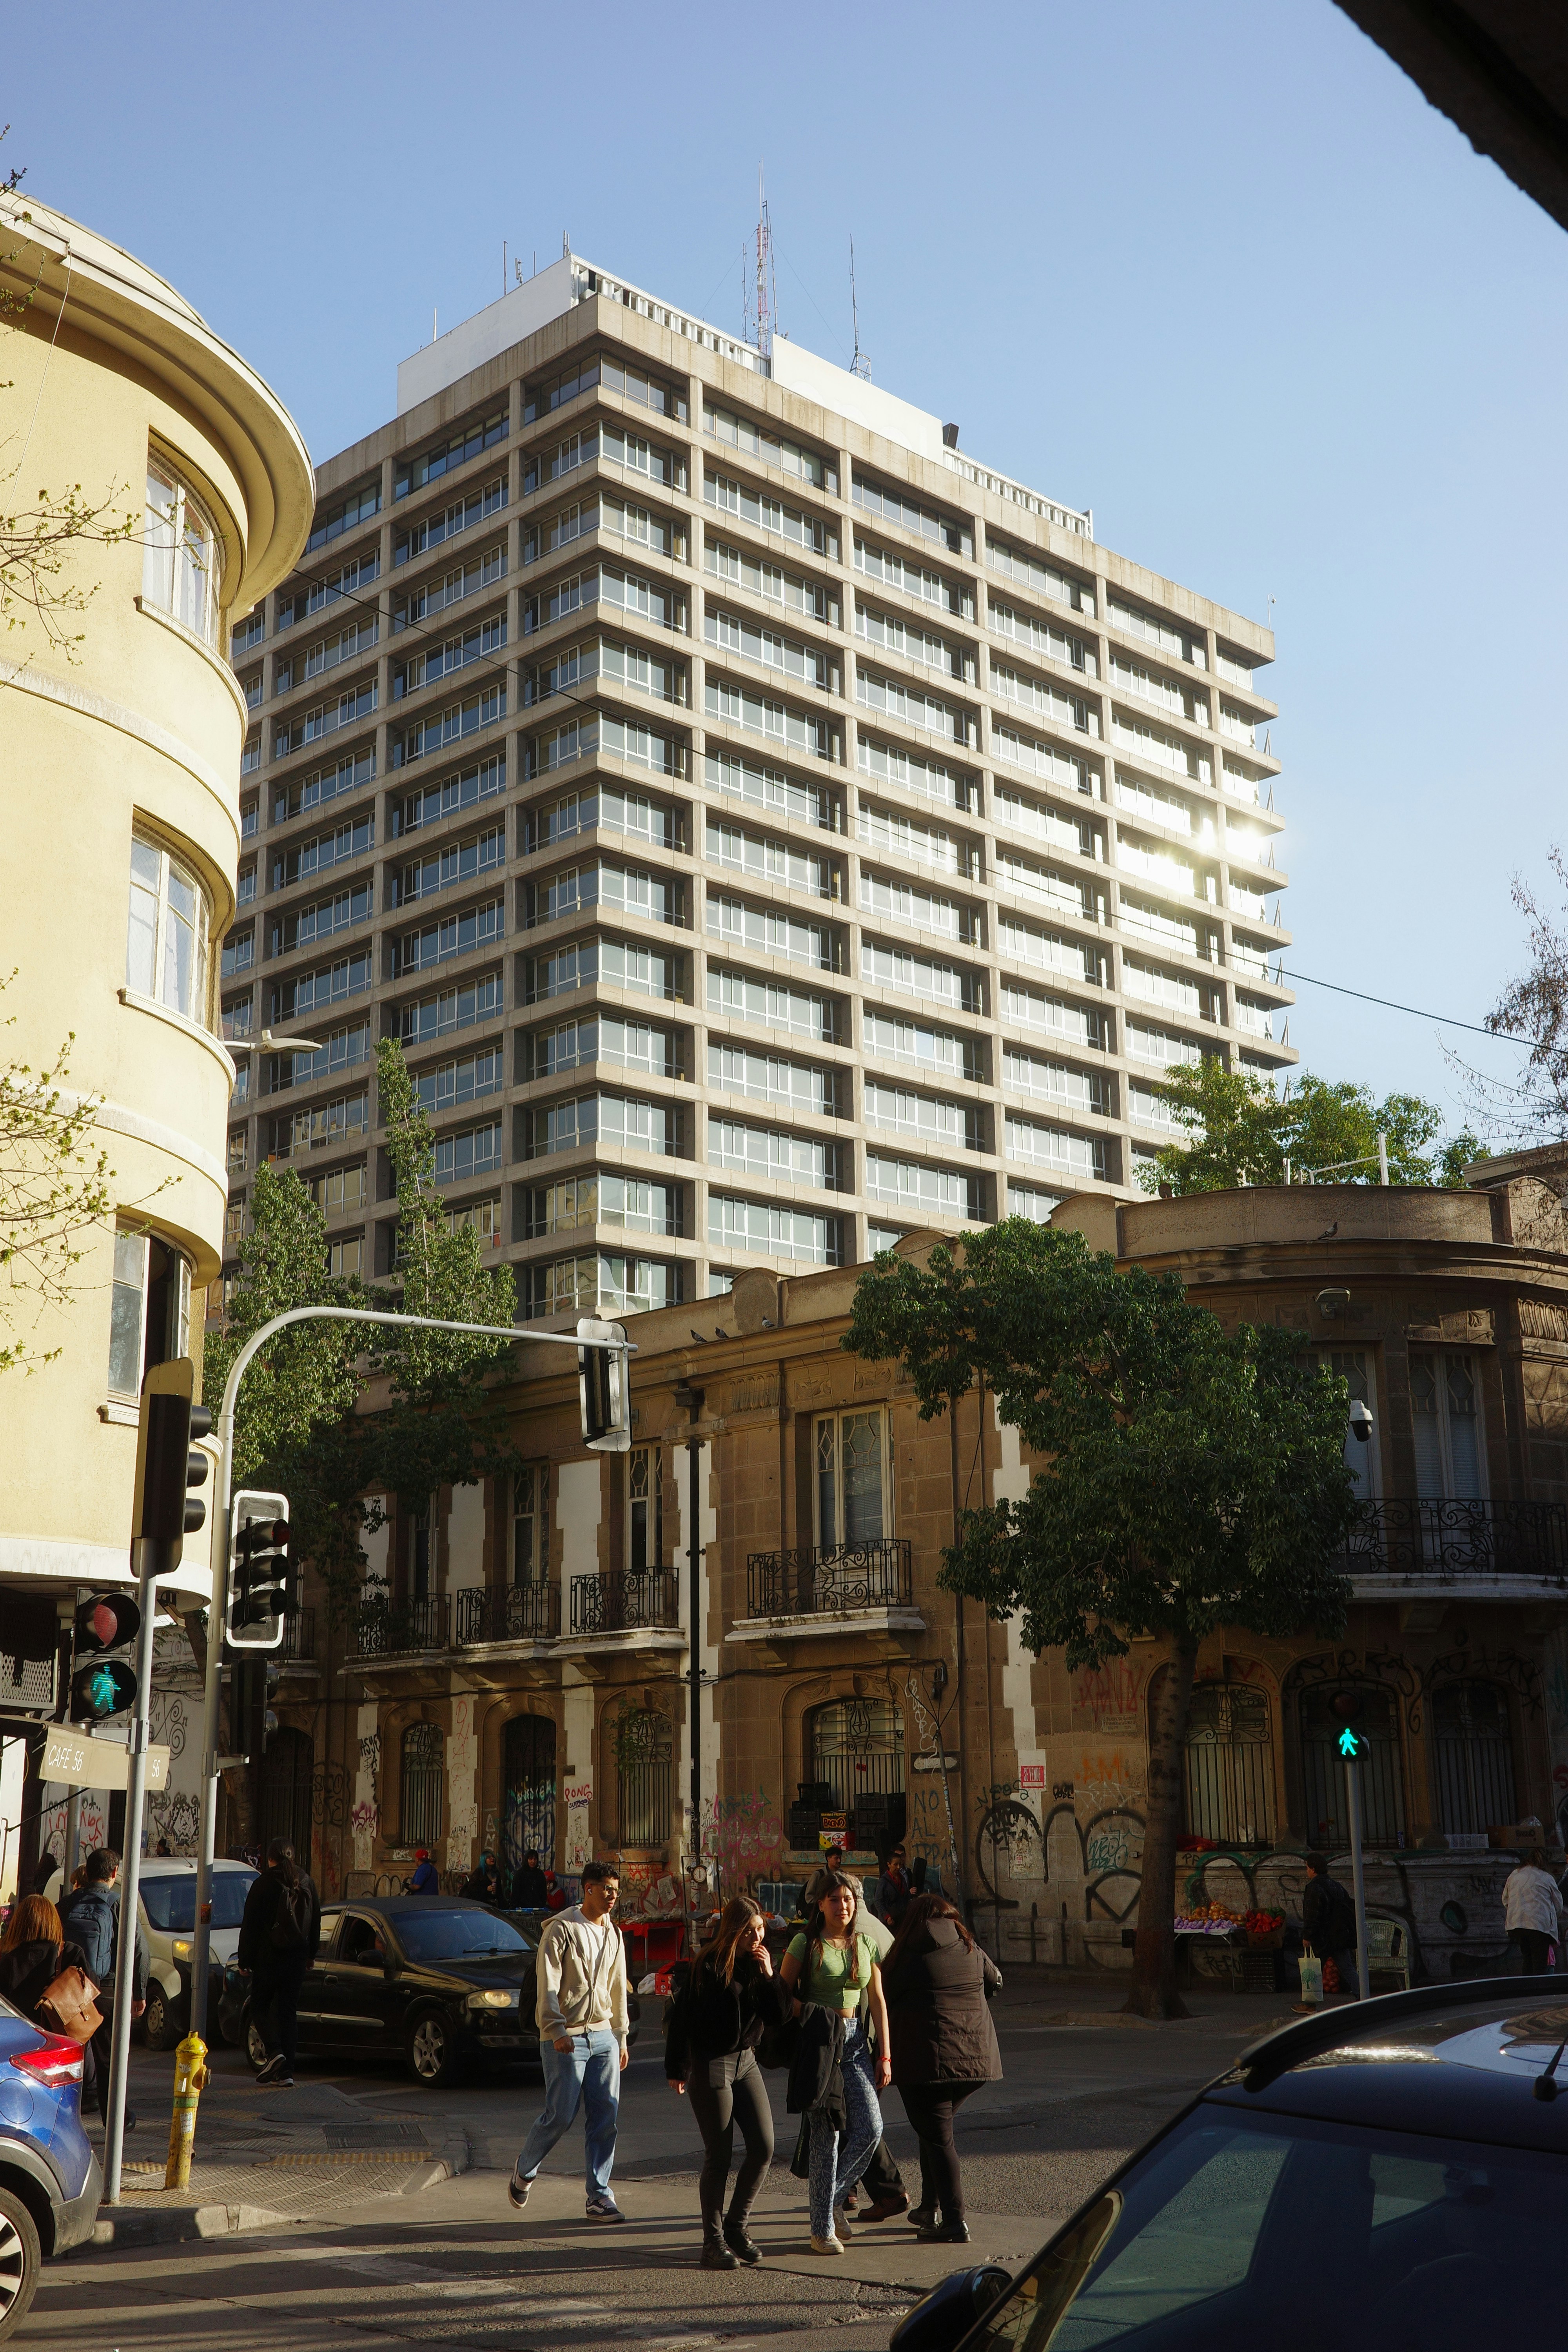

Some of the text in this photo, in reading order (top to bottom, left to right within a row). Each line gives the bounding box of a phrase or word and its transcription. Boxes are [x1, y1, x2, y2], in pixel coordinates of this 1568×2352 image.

[48, 1743, 84, 1771] CAFÉ 56
[152, 1759, 161, 1778] 56
[1024, 1767, 1041, 1781] SE VENDE
[914, 1789, 940, 1813] NO
[911, 1816, 935, 1839] AL
